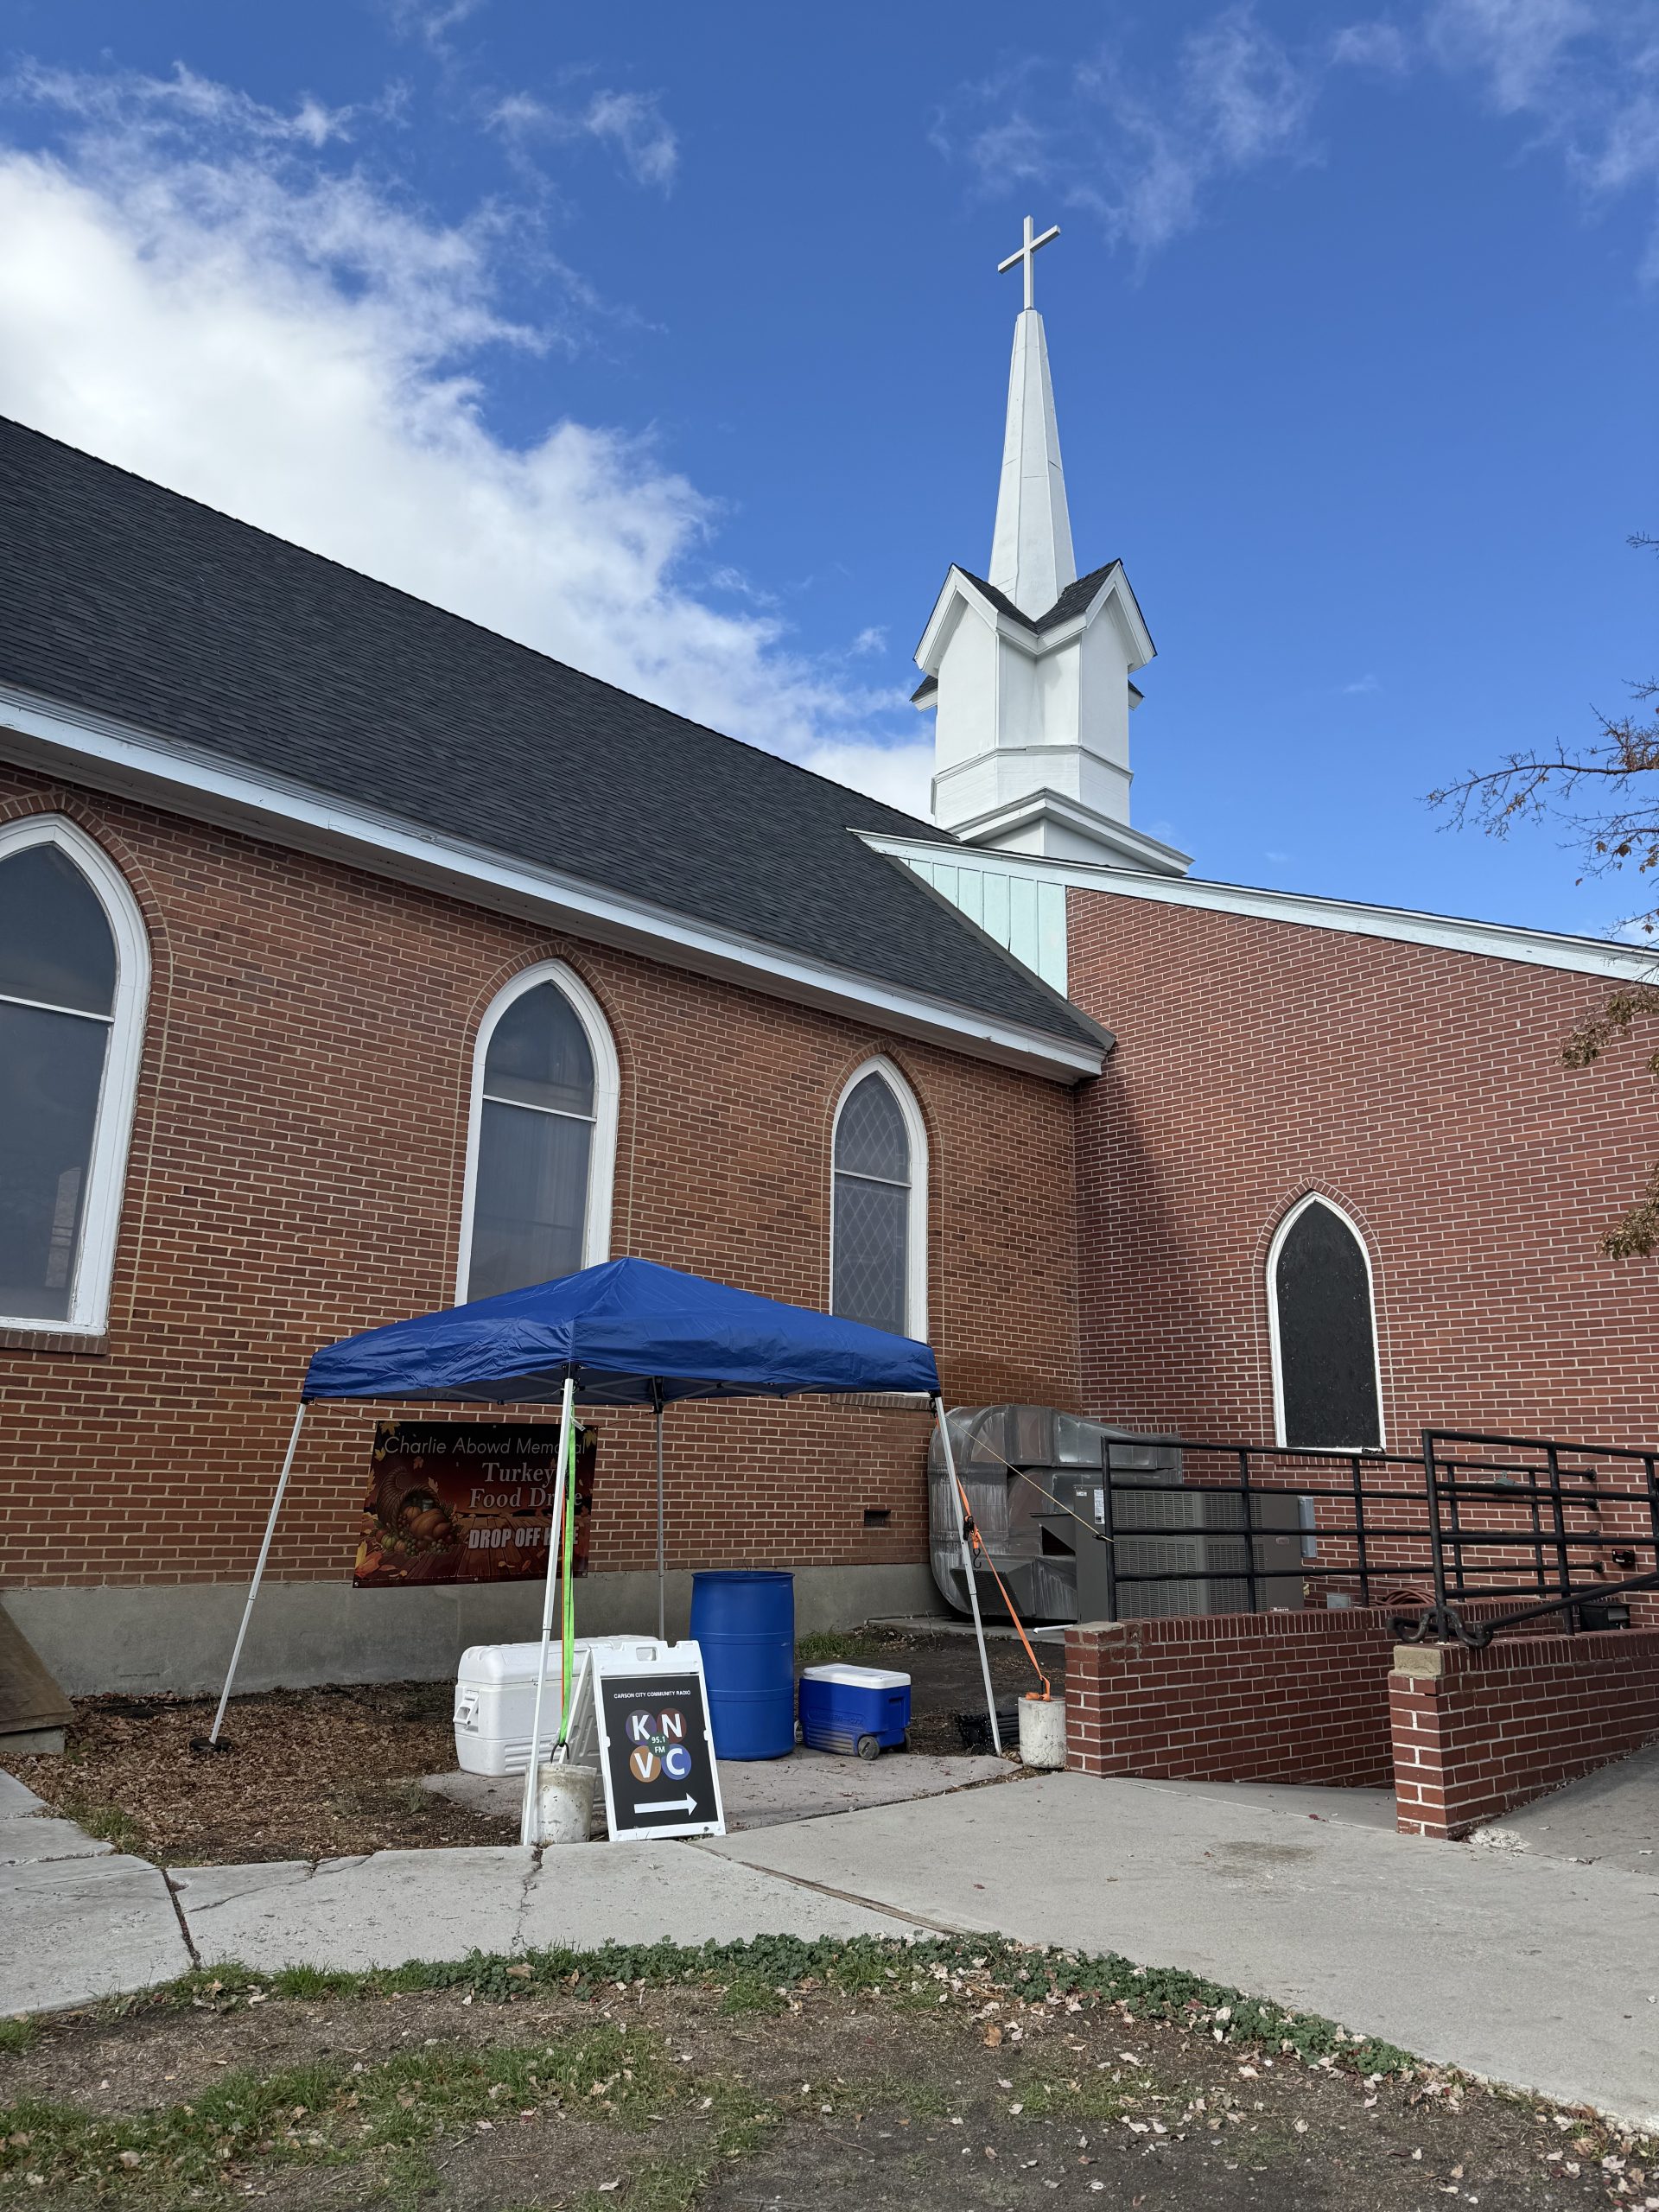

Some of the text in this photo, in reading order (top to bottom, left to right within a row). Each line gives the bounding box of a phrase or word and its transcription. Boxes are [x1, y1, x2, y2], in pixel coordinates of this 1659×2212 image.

[385, 1436, 446, 1454] Charlie
[452, 1437, 511, 1454] Abowd
[482, 1462, 555, 1488] Turkey
[469, 1487, 583, 1508] Food Dre
[468, 1529, 512, 1549] DROP
[515, 1528, 541, 1548] OFF
